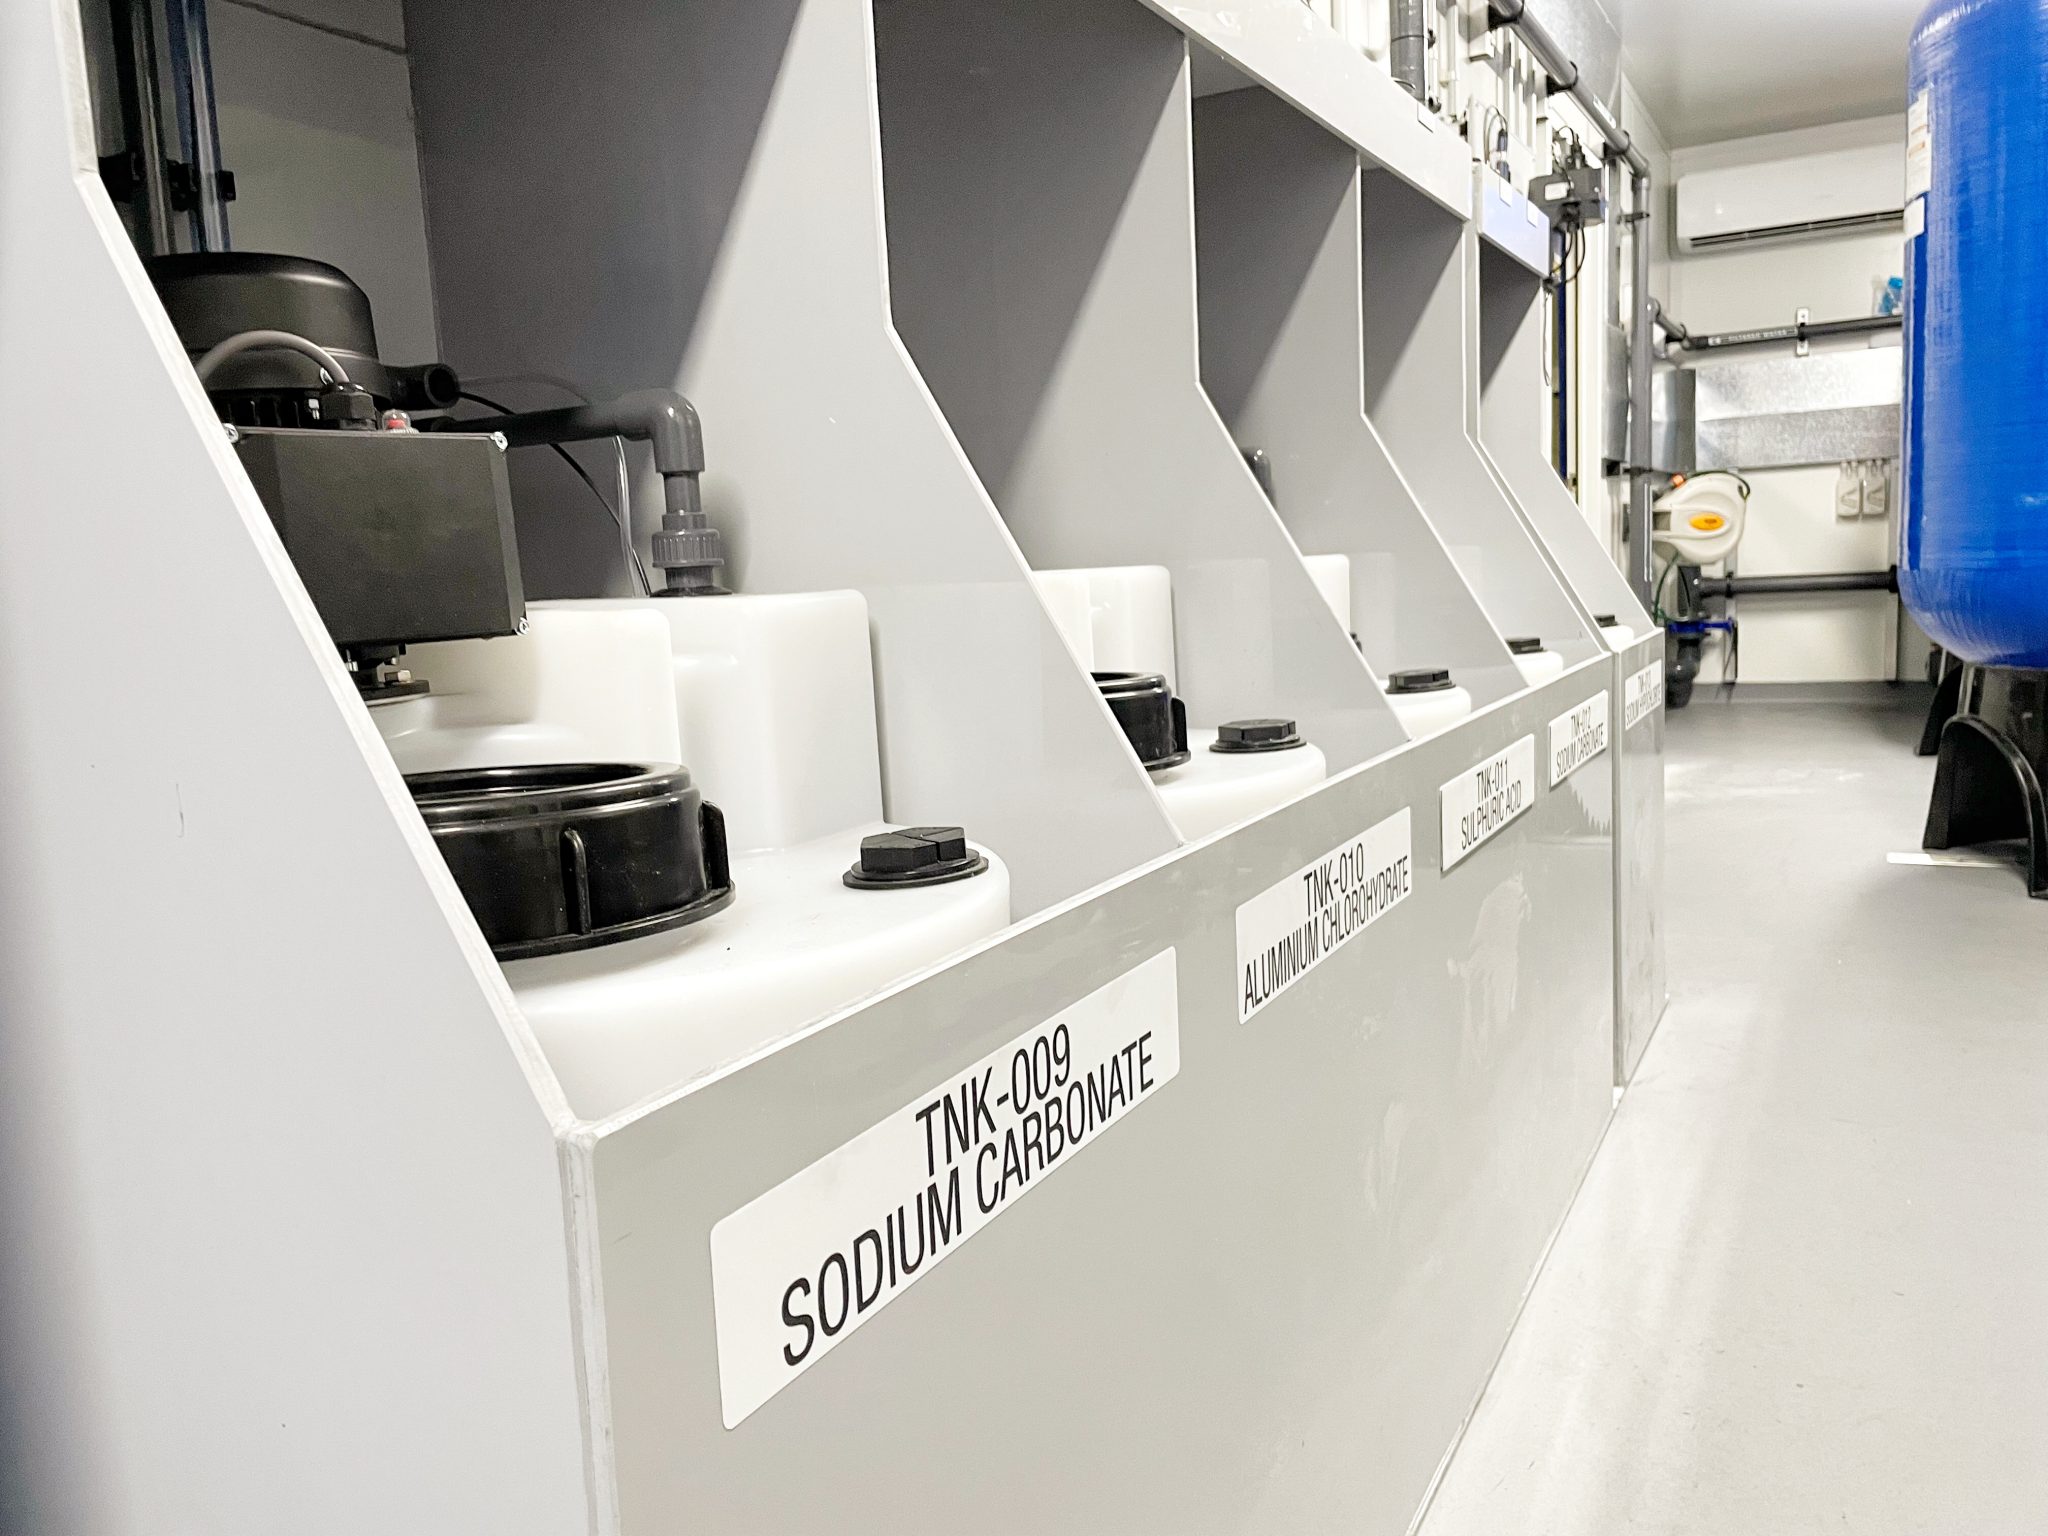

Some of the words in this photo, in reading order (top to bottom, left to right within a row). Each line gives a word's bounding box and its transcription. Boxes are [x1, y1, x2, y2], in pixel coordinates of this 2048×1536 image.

[1557, 739, 1576, 779] SODIUM
[1577, 722, 1603, 762] CARBONATE
[1571, 705, 1591, 740] TNK-012
[1462, 790, 1504, 851] SULPHURIC
[1506, 779, 1522, 817] ACID
[1477, 756, 1508, 804] TNK-011
[1303, 842, 1364, 917] TNK-010
[1244, 916, 1319, 1015] ALUMINIUM
[1322, 855, 1409, 952] CHLOROHYDRATE
[915, 1023, 1071, 1177] TNK-009
[781, 1166, 962, 1366] SODIUM
[976, 1030, 1154, 1214] CARBONATE
